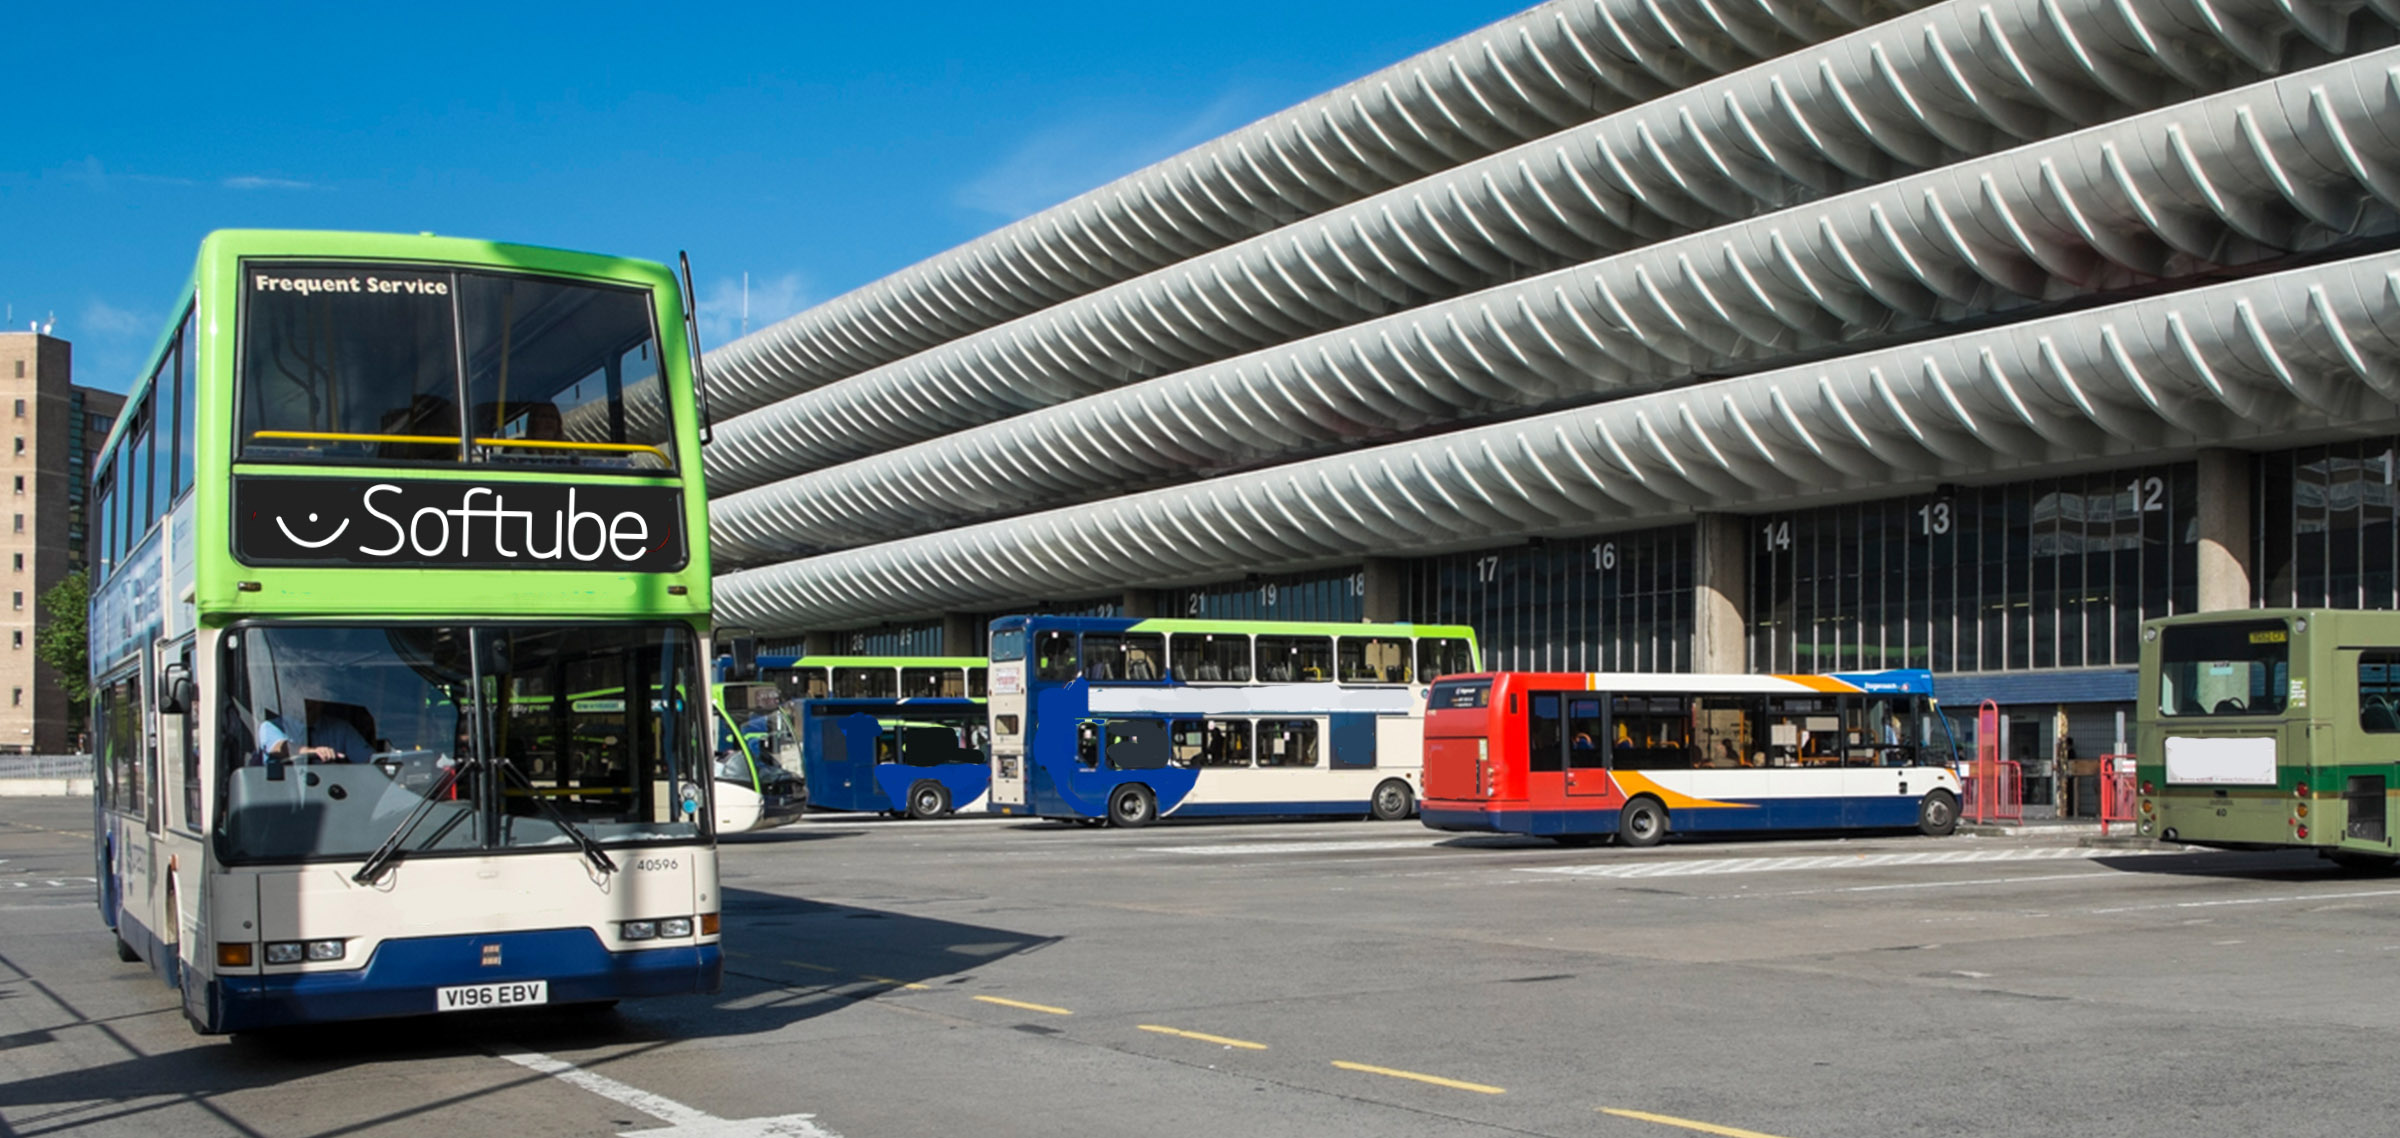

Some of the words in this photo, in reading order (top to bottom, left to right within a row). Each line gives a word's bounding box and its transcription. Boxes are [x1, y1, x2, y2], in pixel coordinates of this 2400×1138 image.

[256, 275, 361, 296] Frequent
[366, 277, 448, 295] Service
[2127, 476, 2164, 512] 12
[359, 483, 648, 562] Softube
[1917, 502, 1950, 535] 13
[1763, 520, 1790, 551] 14
[1592, 542, 1615, 570] 16
[1477, 556, 1498, 582] 17
[1260, 584, 1277, 606] 19
[1348, 573, 1364, 596] 18
[1189, 592, 1205, 614] 21
[637, 859, 678, 871] 40596
[446, 987, 493, 1007] V196
[498, 984, 540, 1005] EBV
